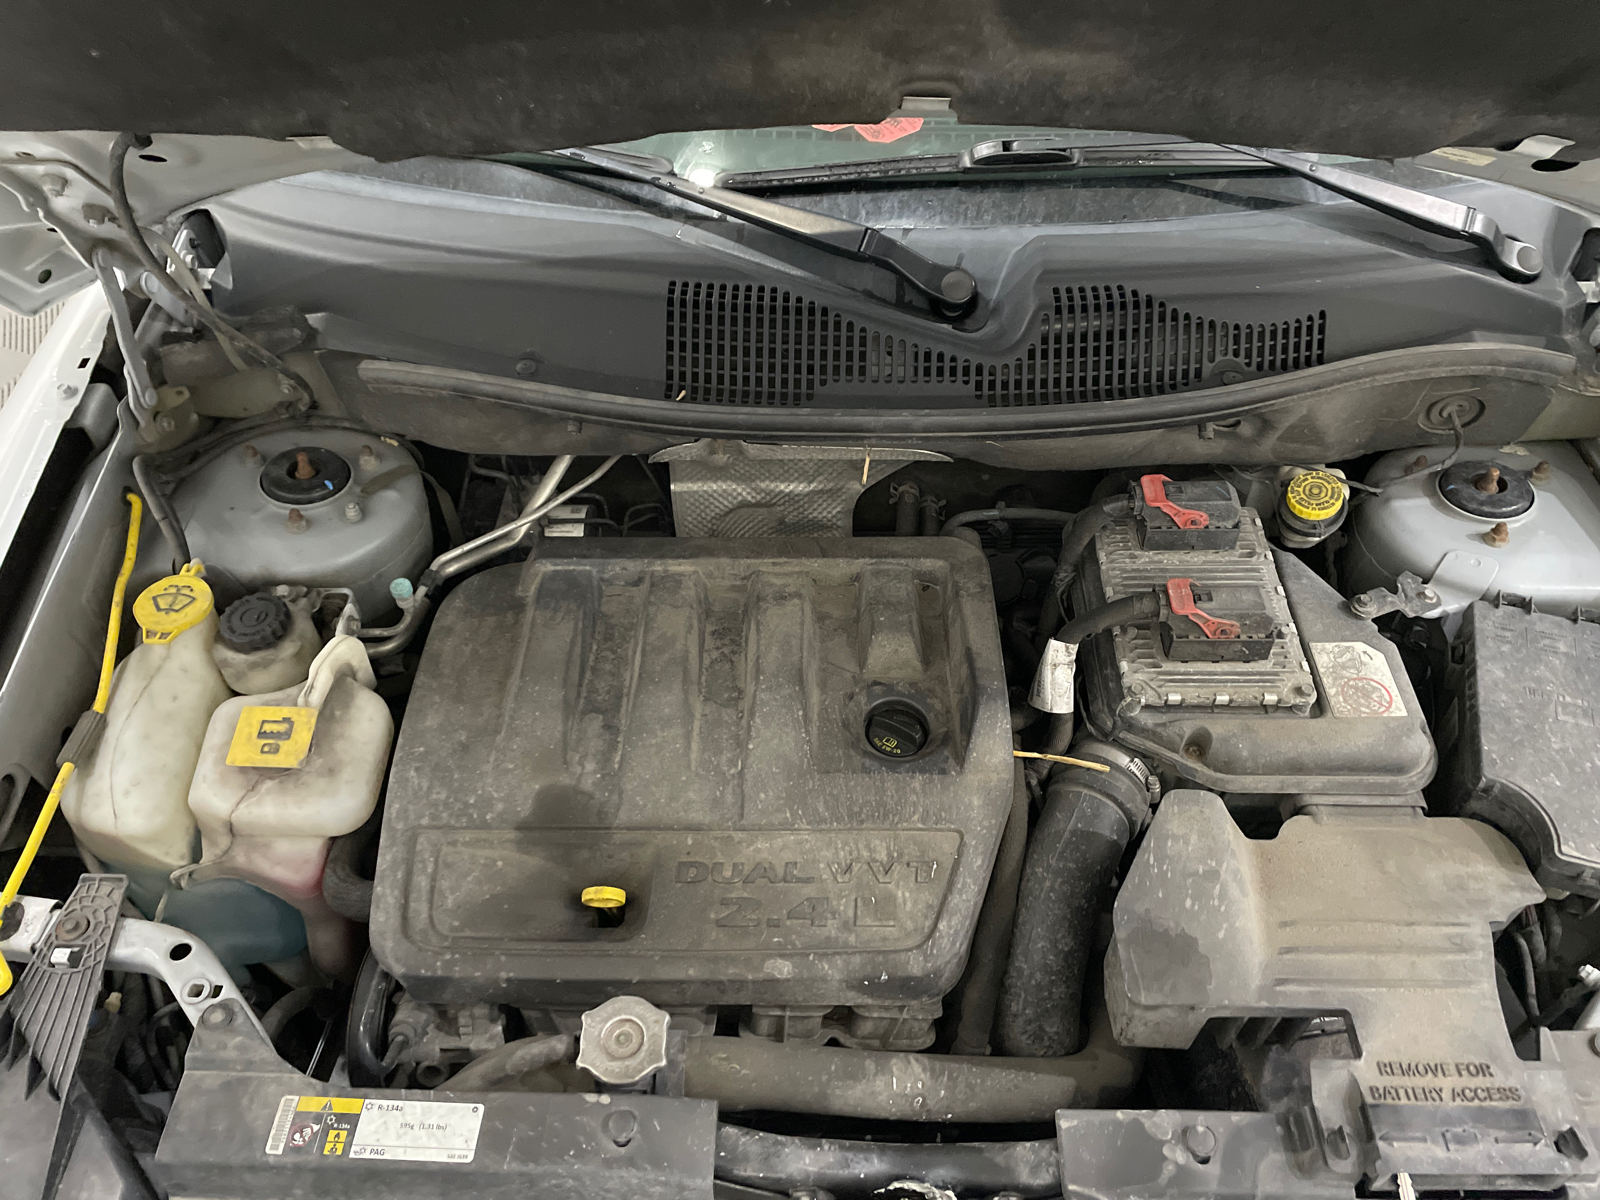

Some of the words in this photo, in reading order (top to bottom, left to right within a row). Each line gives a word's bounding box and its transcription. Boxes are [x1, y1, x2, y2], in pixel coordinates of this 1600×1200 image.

[674, 861, 815, 884] DUAL
[828, 860, 936, 884] VVT
[715, 897, 897, 928] 2.4L
[1376, 1060, 1450, 1078] REMOVE
[1455, 1062, 1495, 1078] FOR
[1368, 1085, 1444, 1102] BATTERY
[1451, 1086, 1522, 1102] ACCESS
[378, 1104, 404, 1112] R-134a
[418, 1122, 434, 1130] (1.31
[436, 1123, 448, 1131] lbs)
[369, 1148, 385, 1156] PAG
